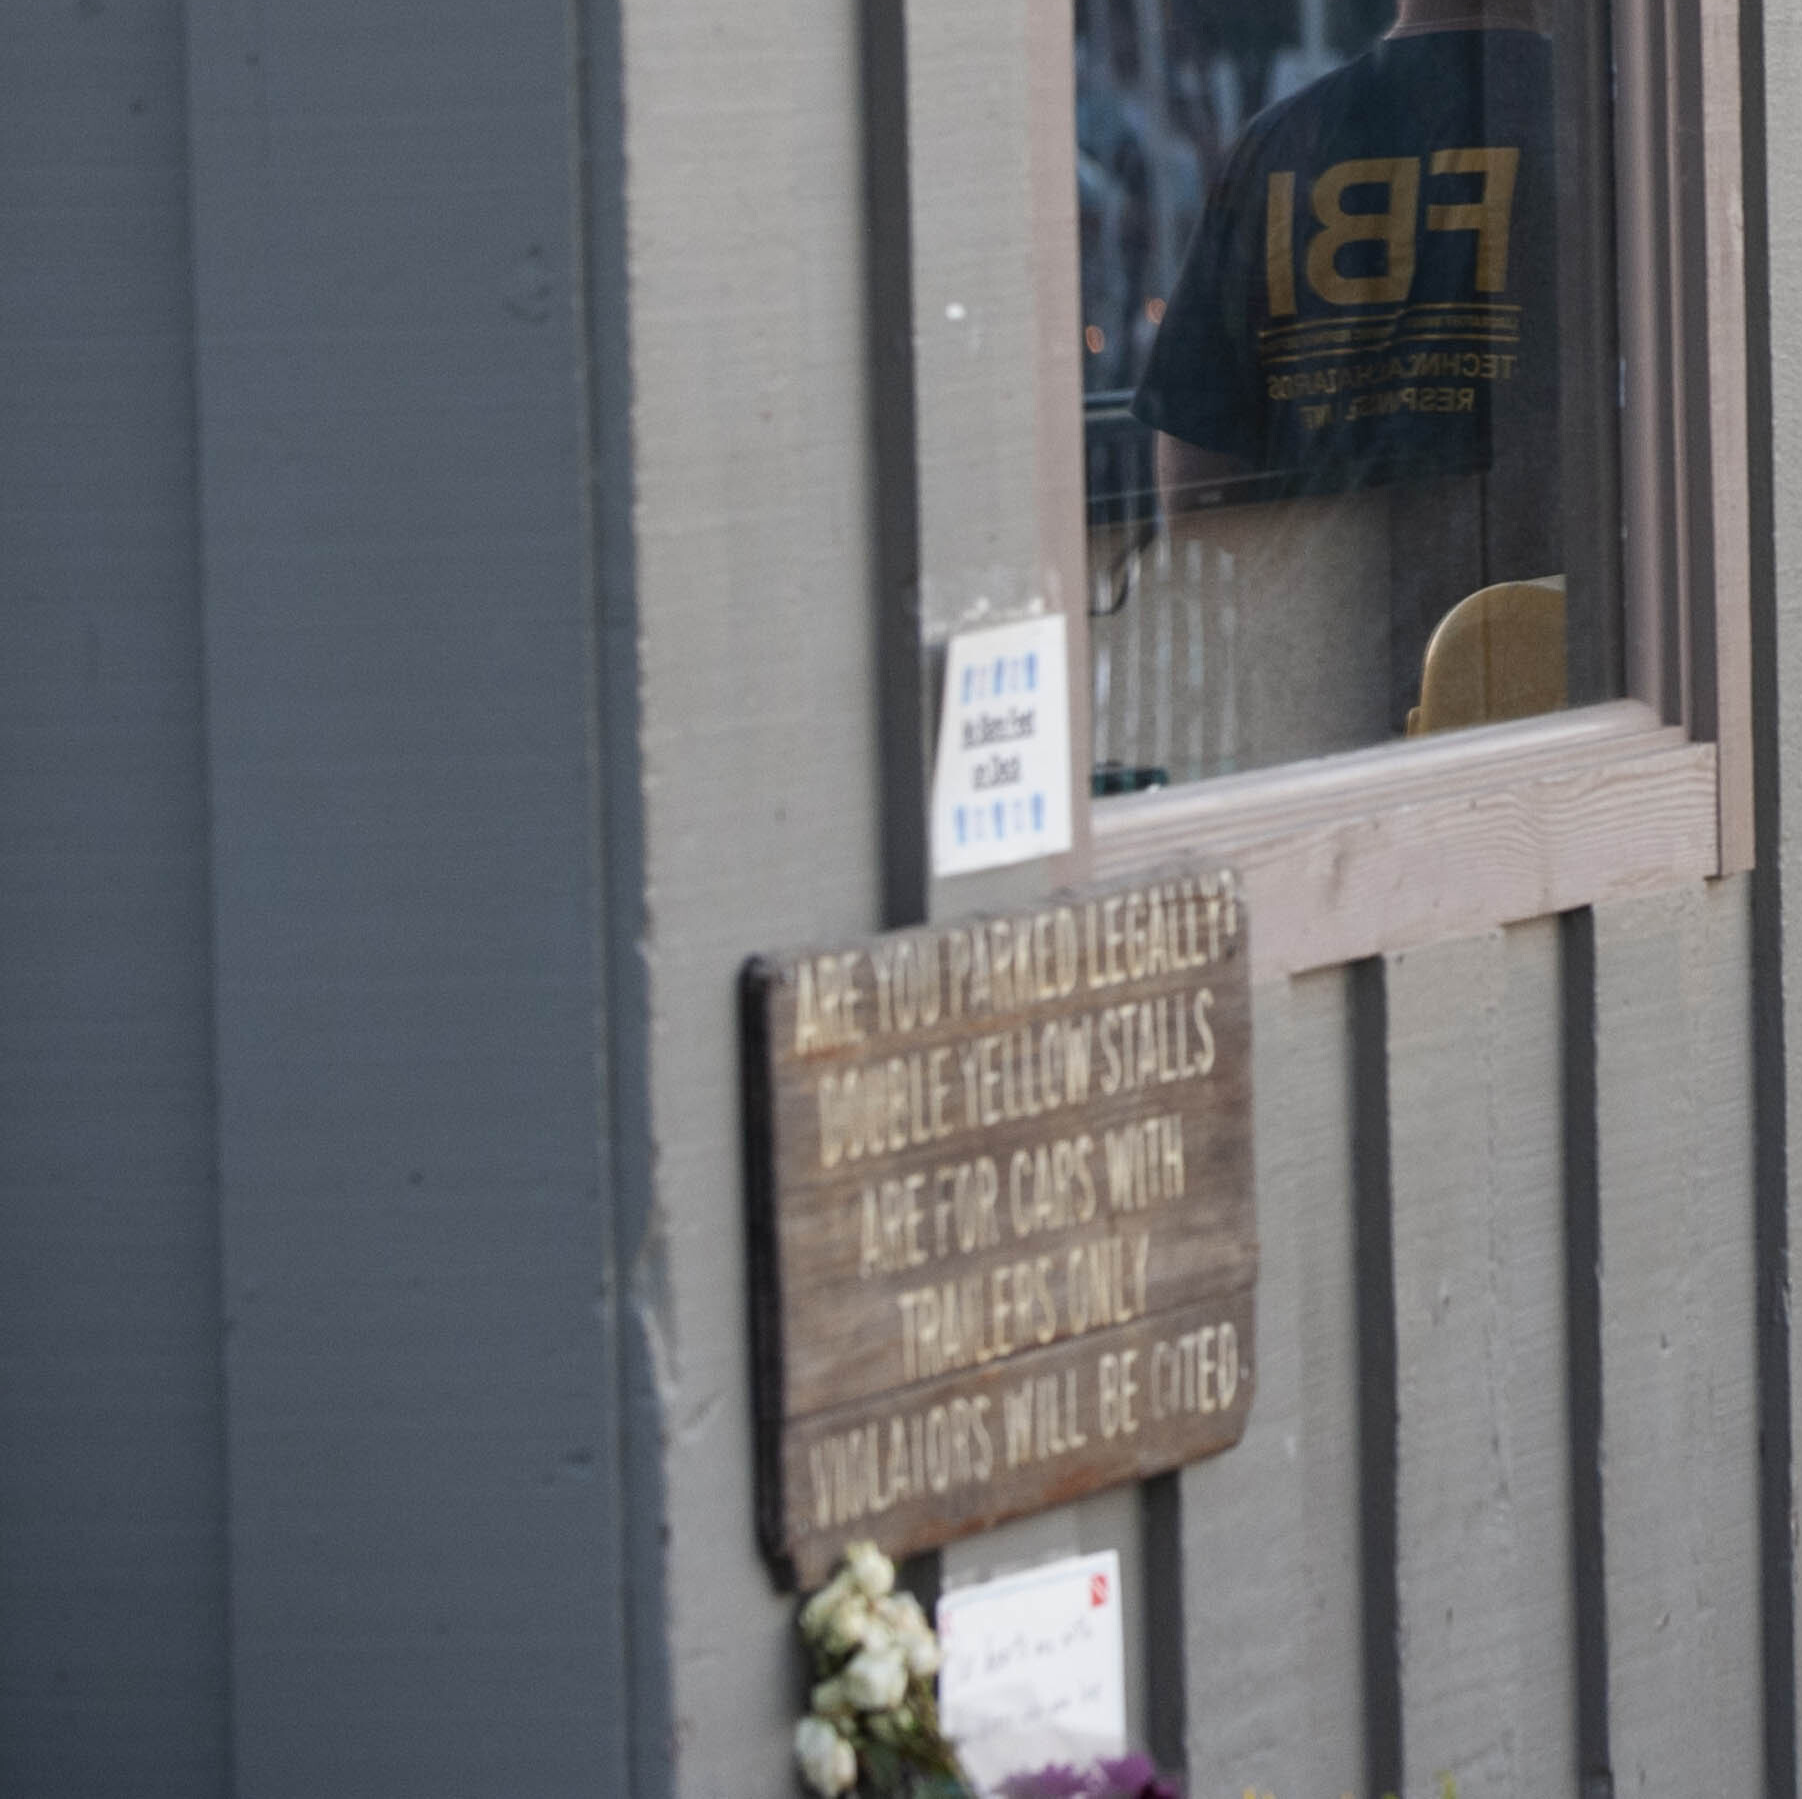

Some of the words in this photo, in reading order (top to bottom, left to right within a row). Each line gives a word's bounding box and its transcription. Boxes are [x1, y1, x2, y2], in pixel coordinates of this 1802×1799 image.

[796, 952, 866, 1054] ARE
[874, 934, 942, 1033] YOU
[949, 910, 1080, 1010] PARKED
[818, 1046, 954, 1169] DOUBLE
[960, 1016, 1093, 1128] YELLOW
[1099, 989, 1218, 1096] STALLS
[859, 1169, 926, 1279] ARE
[936, 1155, 1000, 1254] FOR
[1008, 1135, 1098, 1238] CARS
[1104, 1113, 1187, 1212] WITH
[900, 1255, 1059, 1380] TRAILERS
[1068, 1232, 1152, 1335] ONLY
[809, 1394, 997, 1530] VIOLATORS
[1003, 1369, 1088, 1470] WILL
[1098, 1350, 1141, 1438] BE
[1149, 1321, 1240, 1419] CITED
